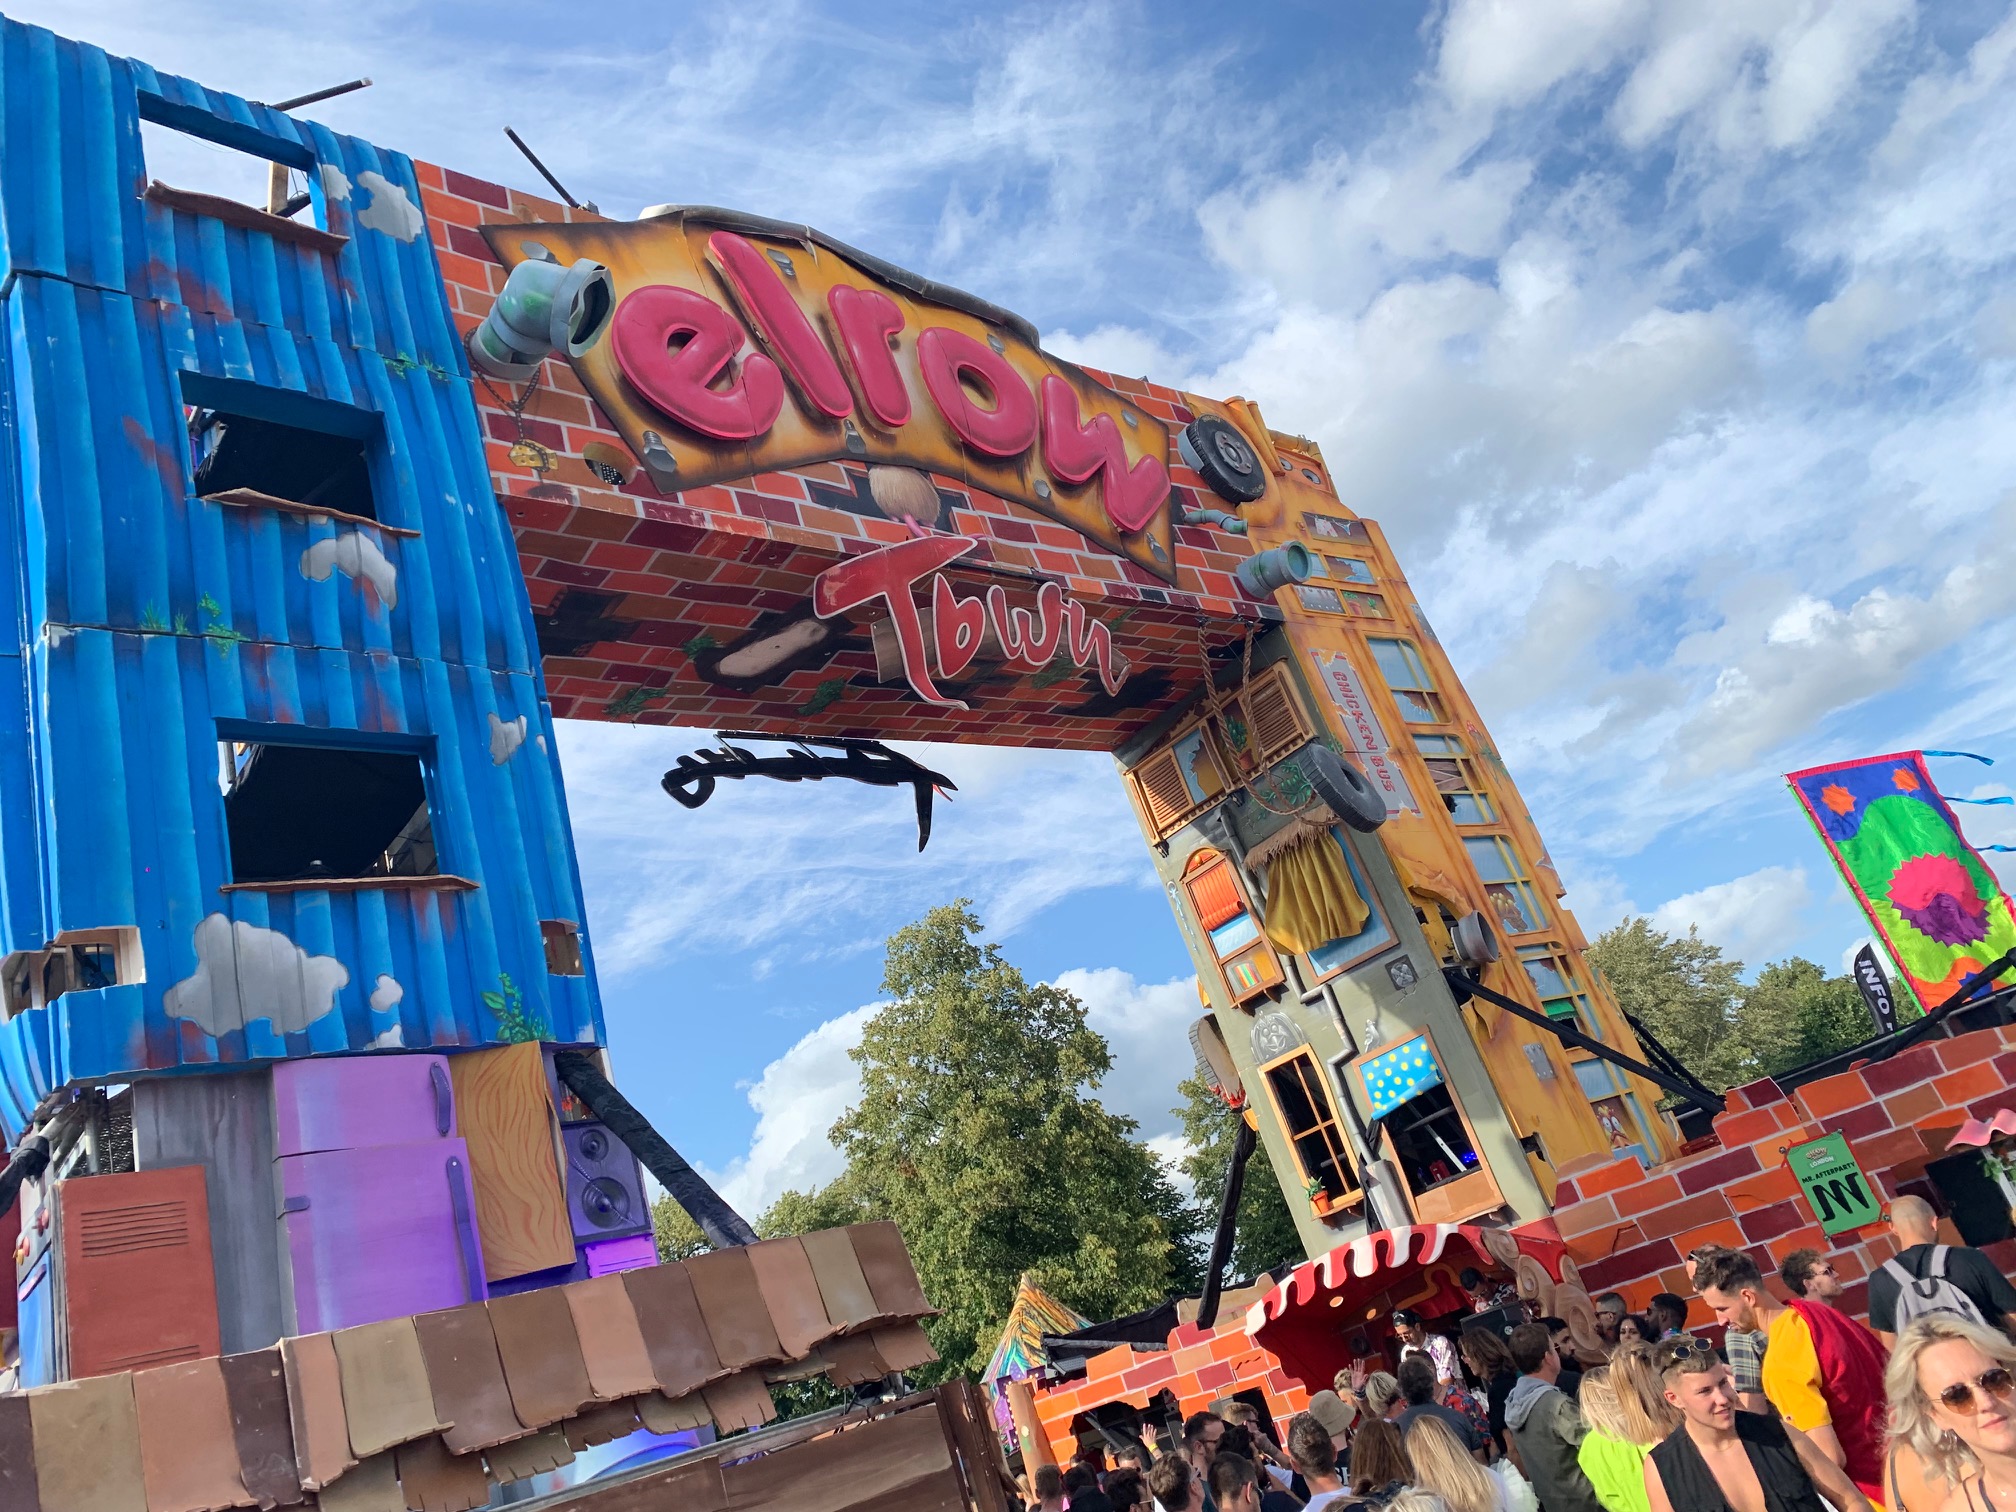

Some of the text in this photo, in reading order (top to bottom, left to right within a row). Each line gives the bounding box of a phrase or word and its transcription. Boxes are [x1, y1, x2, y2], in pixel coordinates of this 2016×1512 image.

[612, 230, 1171, 533] elrow
[1370, 755, 1396, 792] BUS
[1859, 960, 1890, 1015] INFO
[1810, 1156, 1834, 1168] LONDON
[1815, 1162, 1855, 1179] AFTERPARTY
